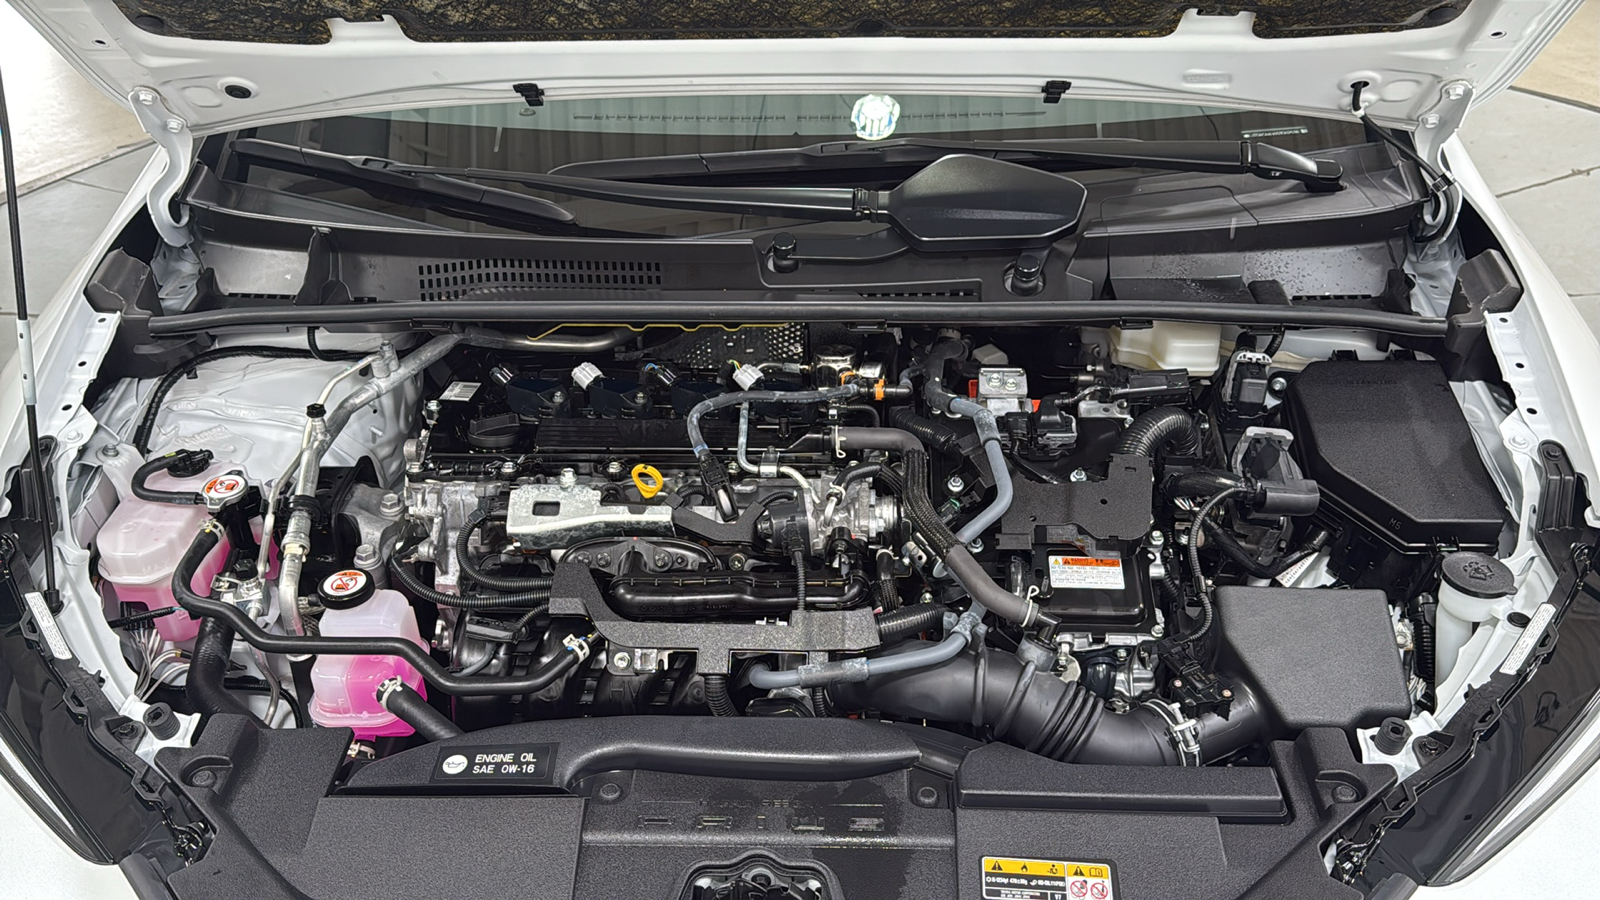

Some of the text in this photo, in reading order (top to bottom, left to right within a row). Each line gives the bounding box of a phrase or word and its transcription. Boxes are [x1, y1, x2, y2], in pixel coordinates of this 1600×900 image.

[475, 752, 537, 763] ENGINE OIL
[472, 764, 495, 773] SAE
